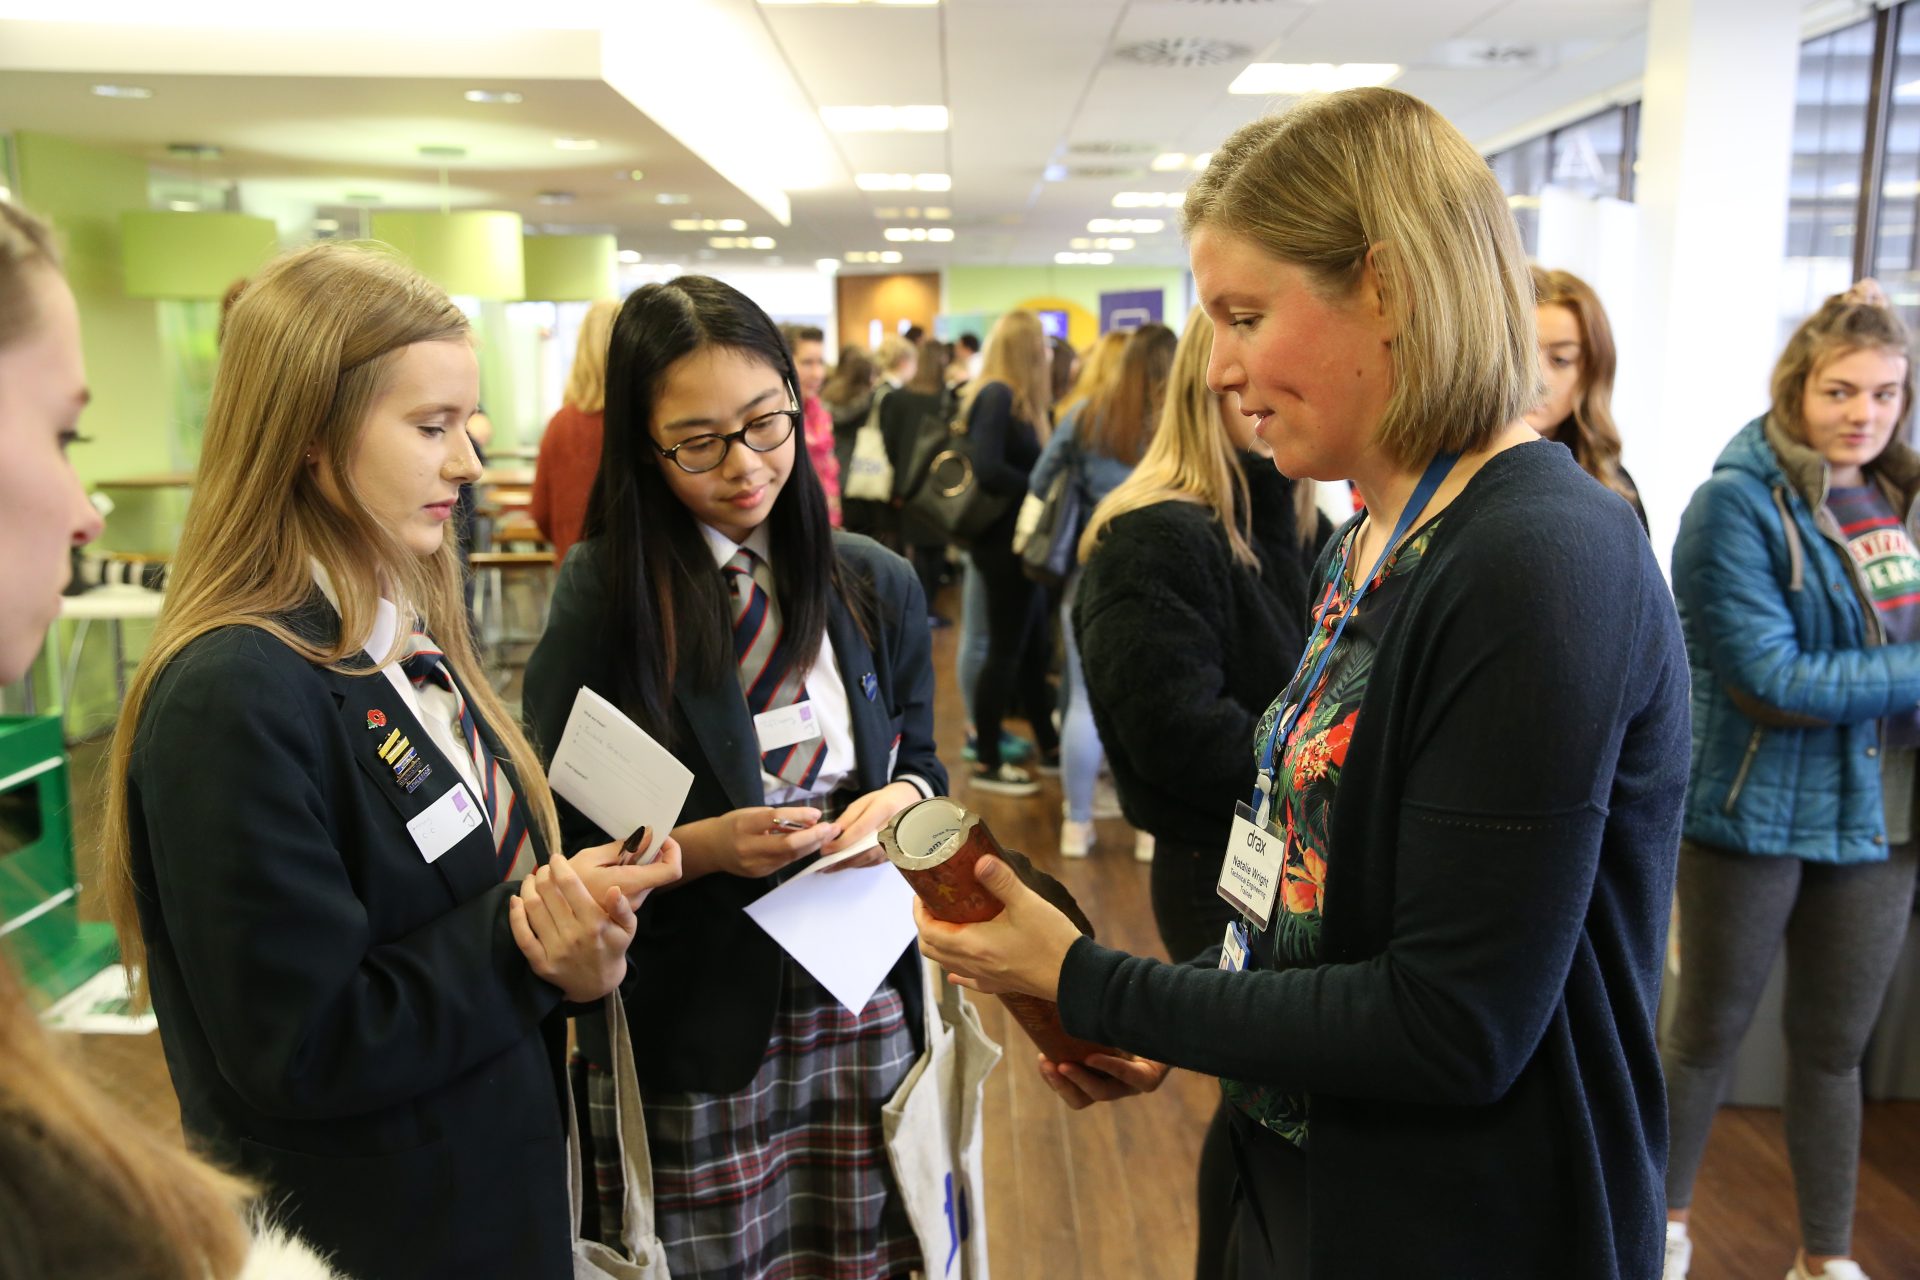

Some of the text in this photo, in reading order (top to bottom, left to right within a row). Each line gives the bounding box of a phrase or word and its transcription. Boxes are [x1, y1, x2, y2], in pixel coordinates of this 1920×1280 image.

[1247, 829, 1267, 857] drax
[1230, 867, 1267, 901] Technical Engineering
[1232, 856, 1269, 889] Natalie Wright
[1240, 885, 1253, 900] Trainee
